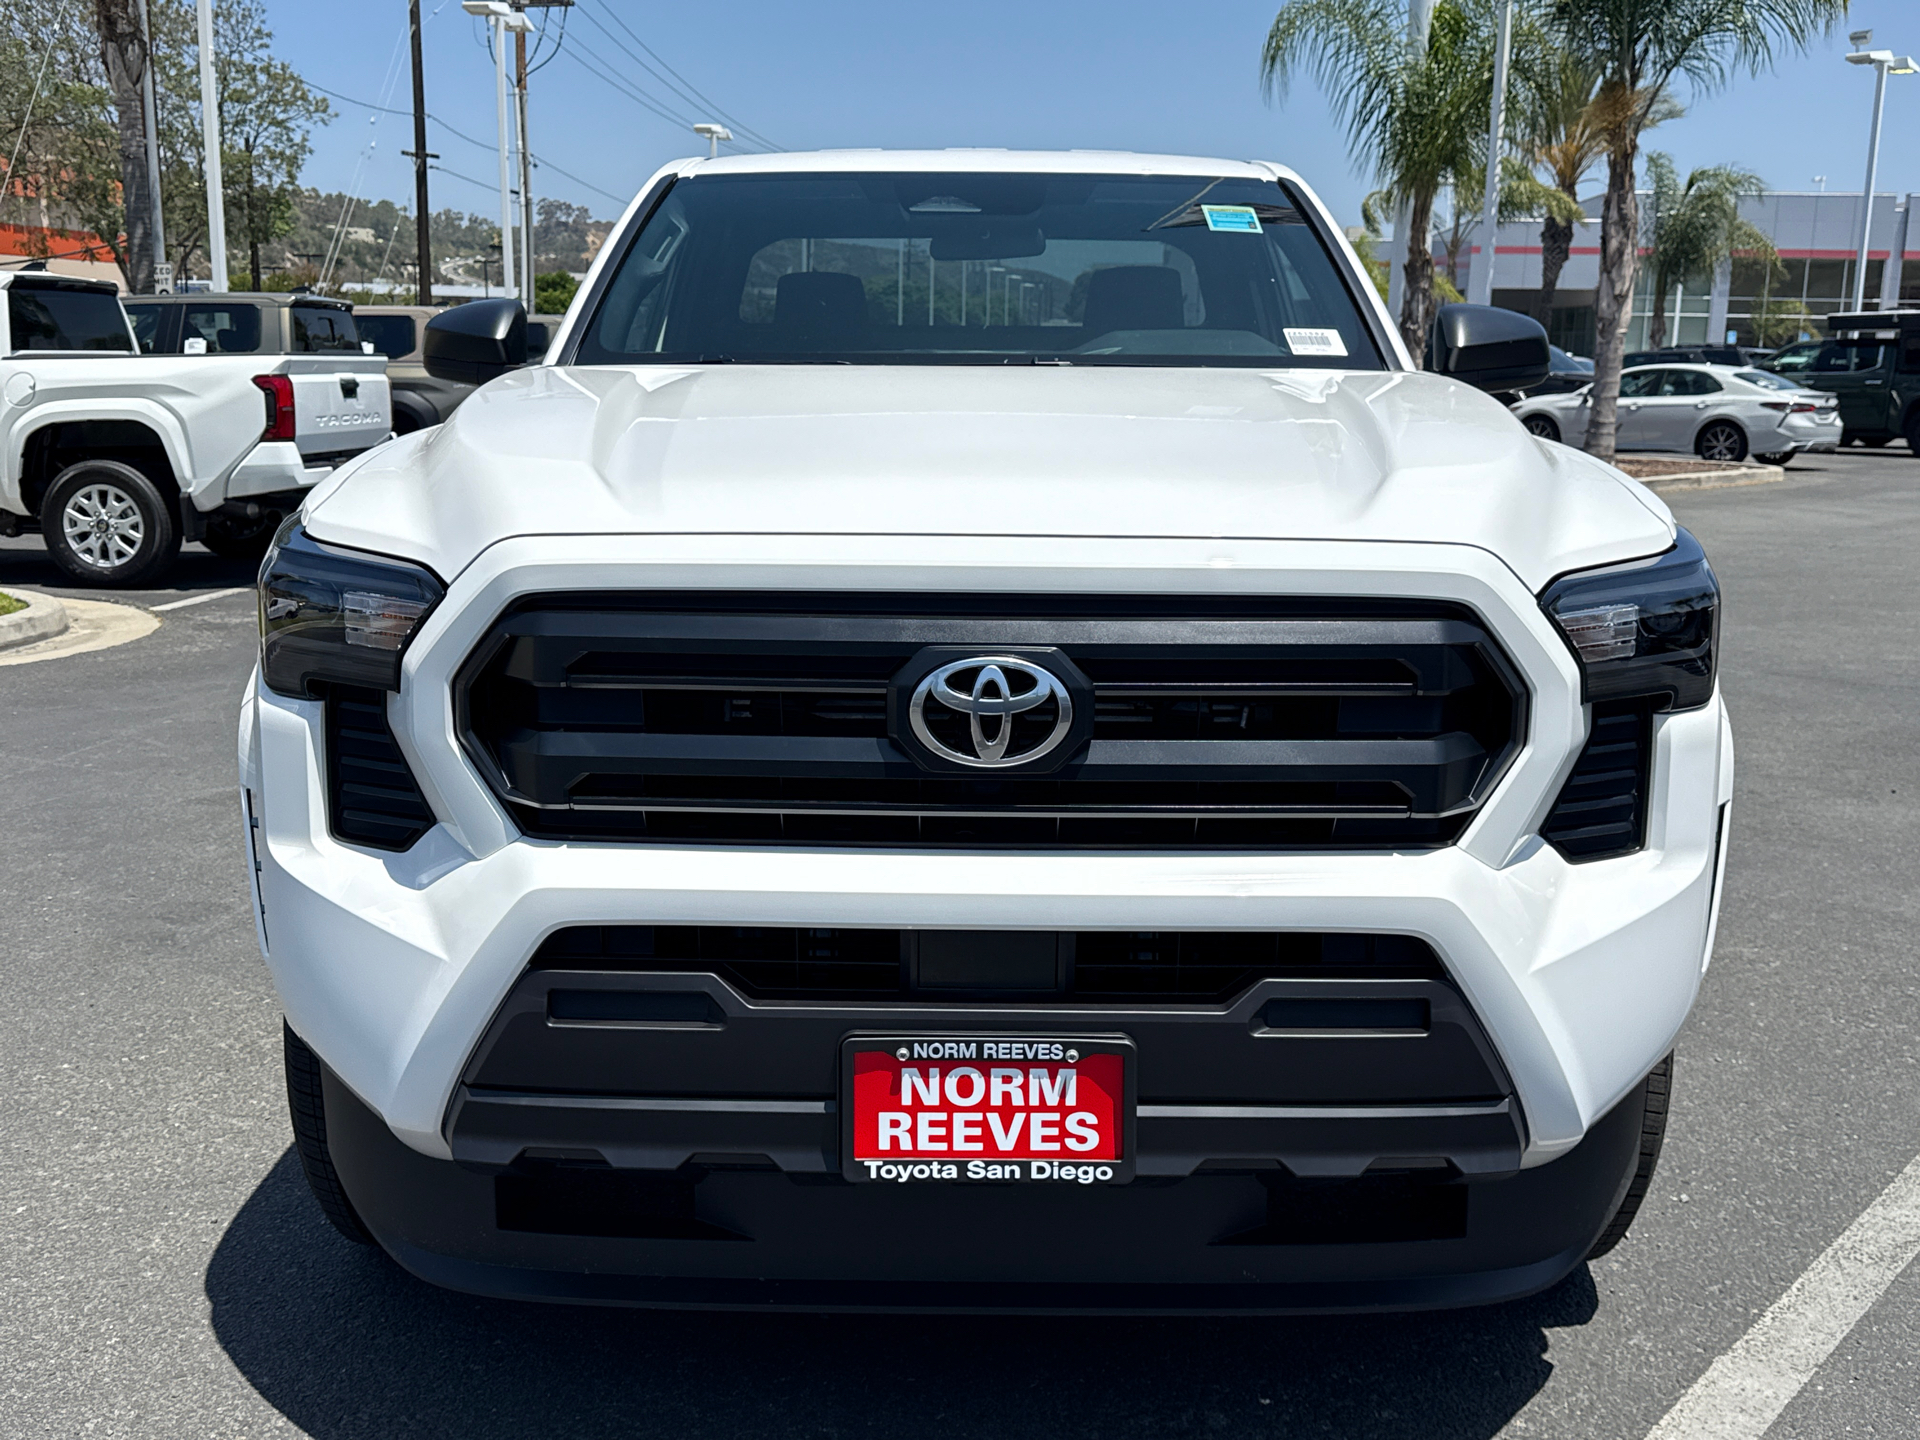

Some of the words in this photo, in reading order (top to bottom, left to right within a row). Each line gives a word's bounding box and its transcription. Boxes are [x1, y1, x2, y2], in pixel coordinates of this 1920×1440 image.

[315, 412, 381, 427] TACOMA
[913, 1043, 976, 1059] NORM
[983, 1043, 1064, 1060] REEVES
[901, 1067, 1077, 1107] NORM
[878, 1111, 1100, 1151] REEVES
[864, 1160, 958, 1181] Toyota
[966, 1160, 1021, 1180] San
[1031, 1161, 1113, 1184] Diego
